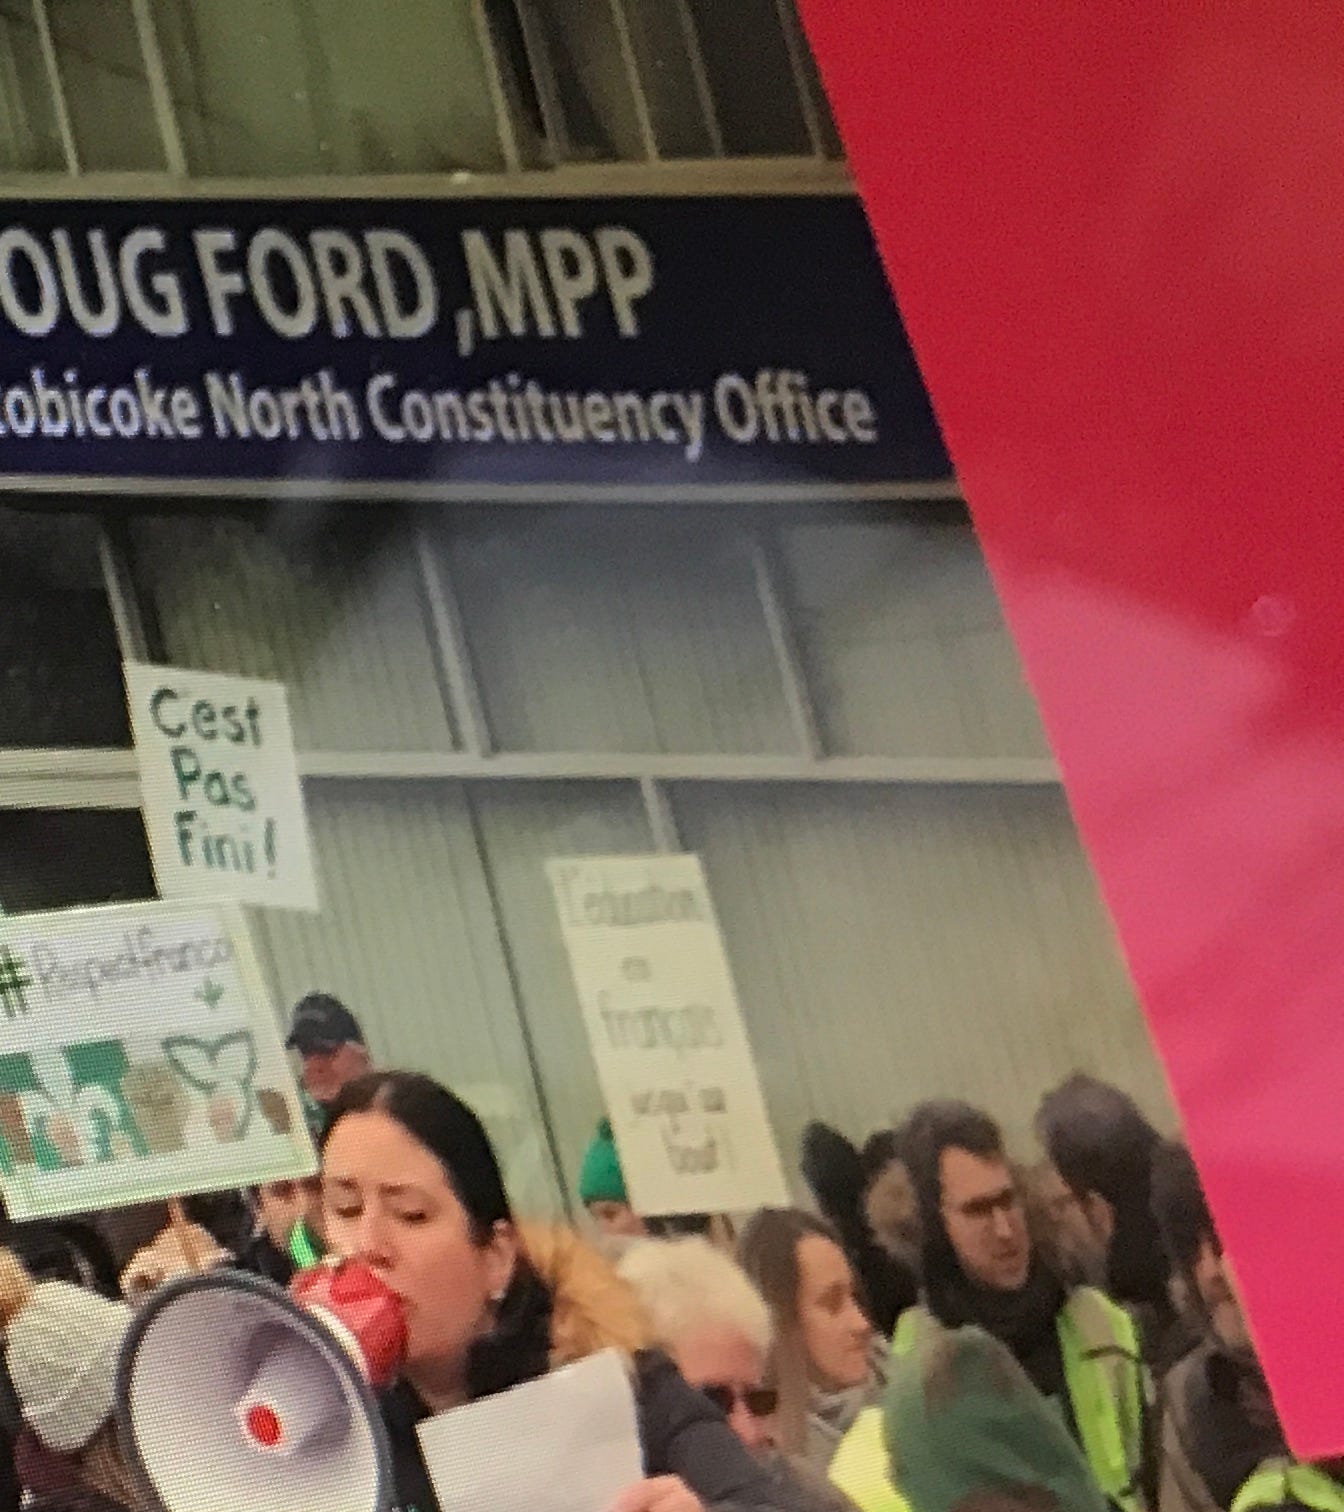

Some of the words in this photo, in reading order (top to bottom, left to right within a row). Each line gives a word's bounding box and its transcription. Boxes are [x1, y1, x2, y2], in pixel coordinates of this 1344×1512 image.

[191, 226, 439, 339] FORD
[205, 369, 361, 440] North
[366, 371, 704, 462] Constituency
[715, 369, 878, 443] Office
[169, 747, 256, 811] Pas
[174, 810, 276, 879] Fini!
